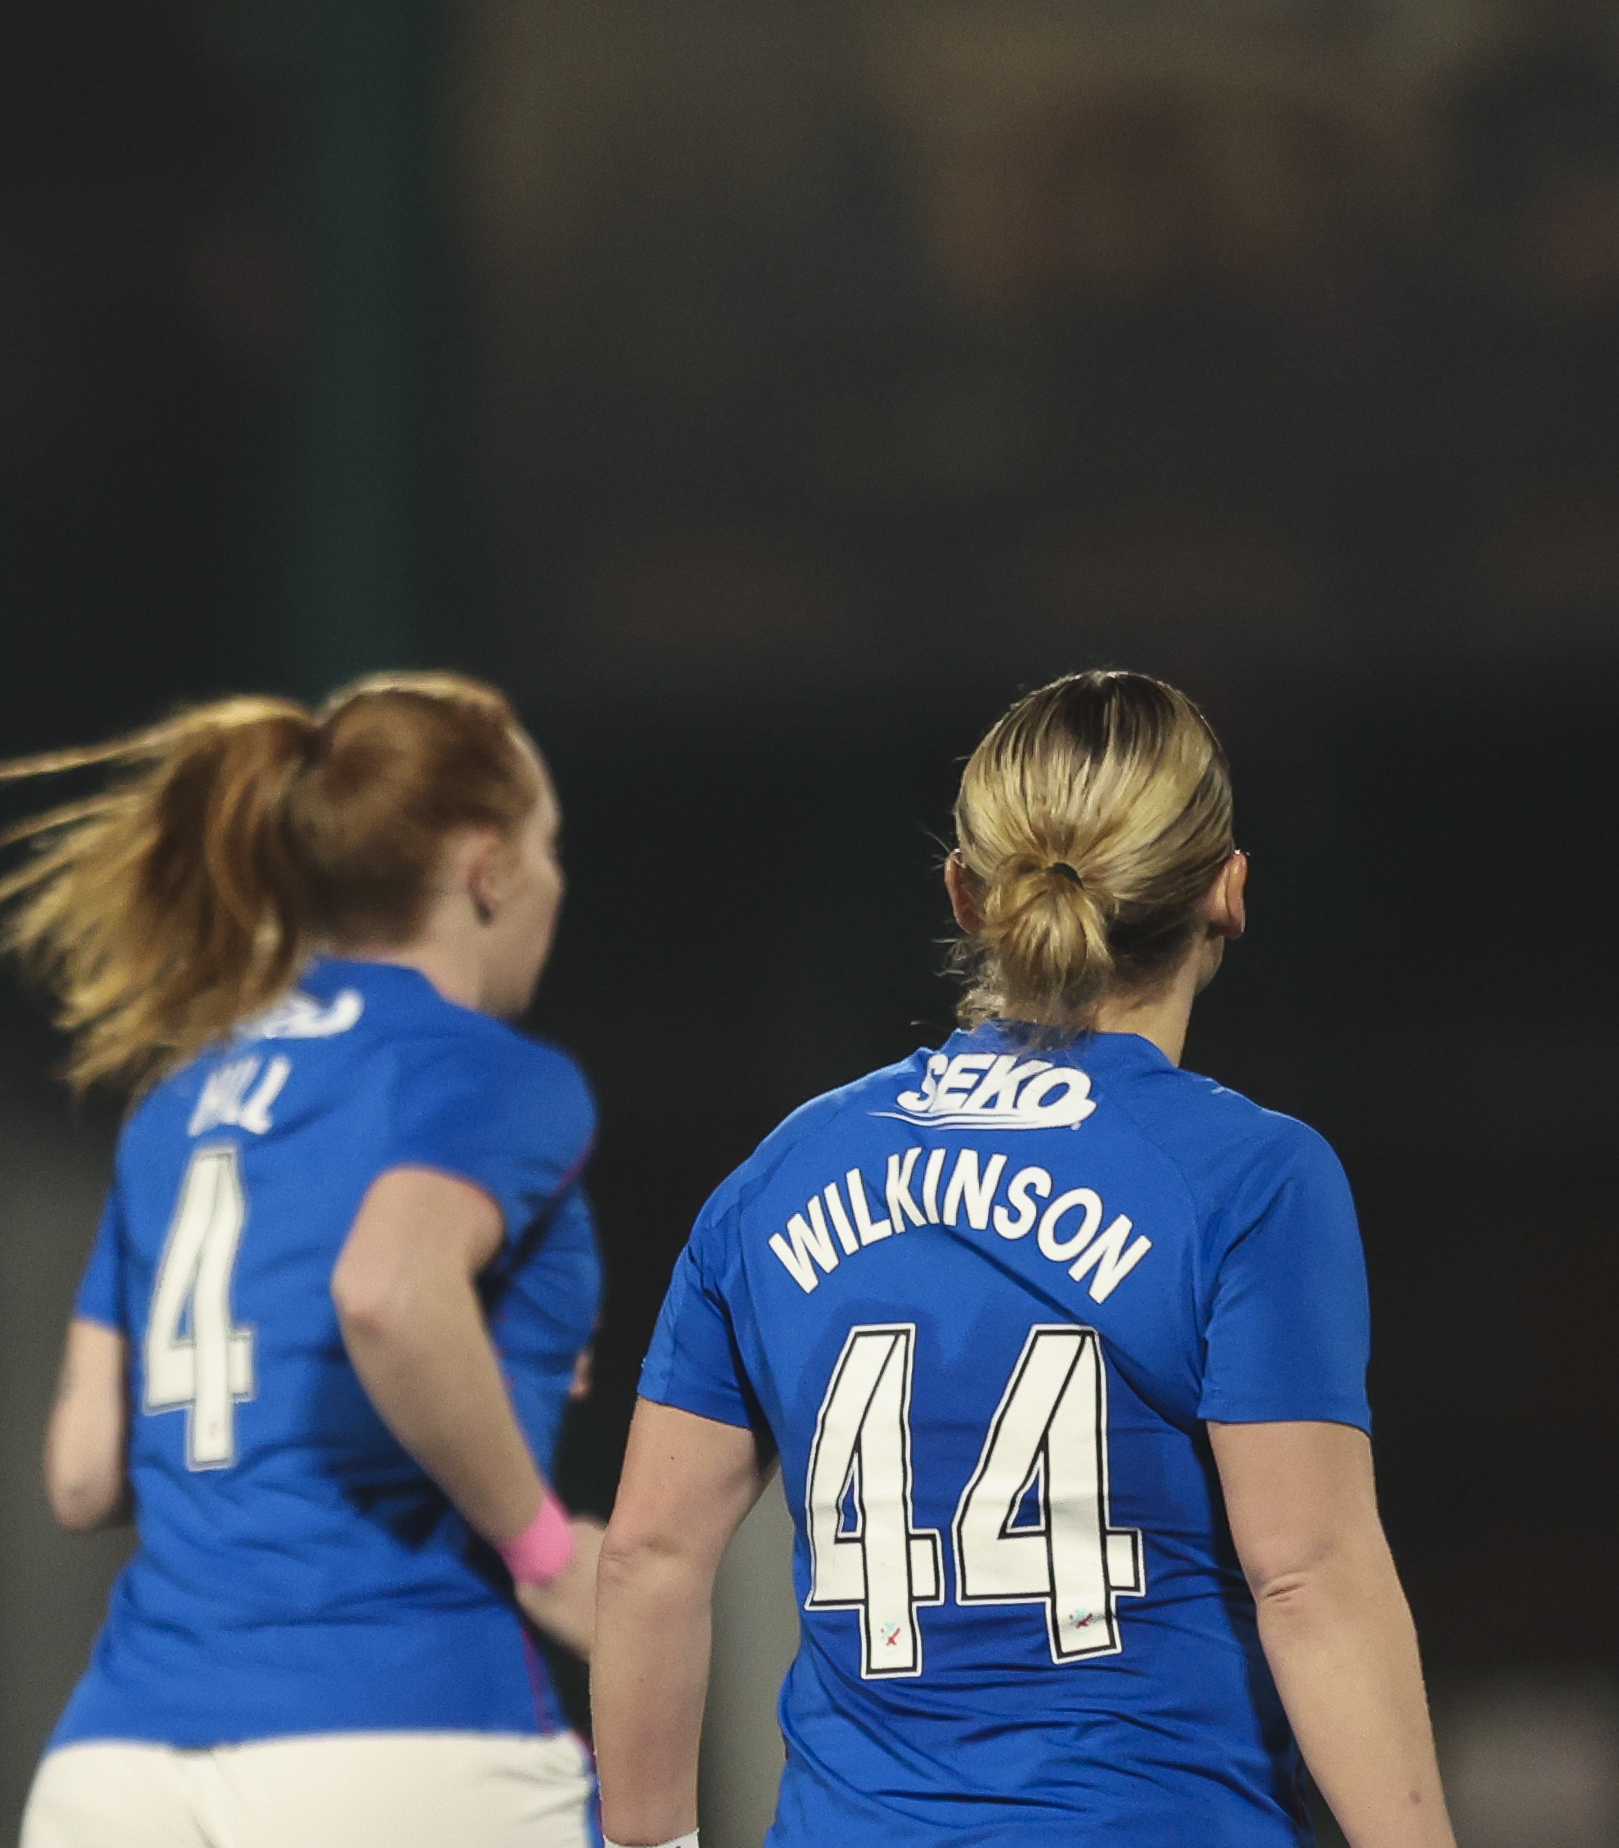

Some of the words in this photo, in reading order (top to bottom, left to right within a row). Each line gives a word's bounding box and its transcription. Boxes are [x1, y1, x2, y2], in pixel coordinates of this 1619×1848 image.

[889, 1053, 1098, 1131] SEKO
[143, 1144, 254, 1473] 4
[768, 1146, 1153, 1304] WILKINSON
[804, 1322, 1146, 1679] 44
